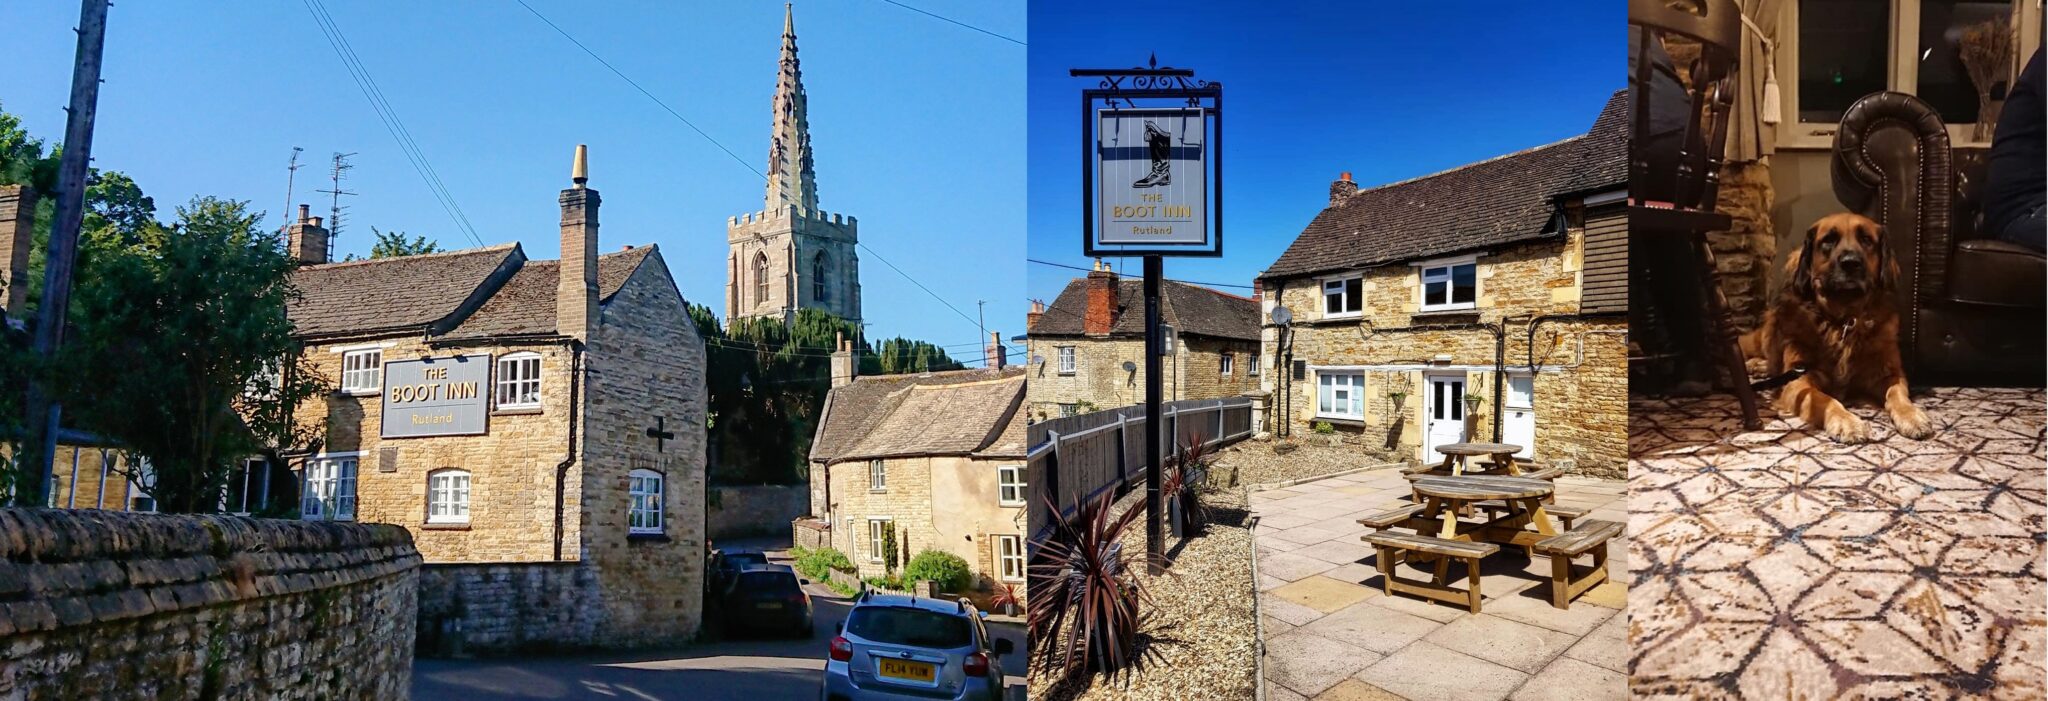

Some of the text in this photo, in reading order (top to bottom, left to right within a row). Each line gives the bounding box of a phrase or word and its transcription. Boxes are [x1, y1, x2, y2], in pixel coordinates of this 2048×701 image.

[1142, 194, 1163, 203] THE
[1113, 205, 1191, 218] BOOT INN
[1133, 226, 1172, 235] Rutland
[423, 367, 448, 380] THE
[391, 381, 478, 403] BOOT INN
[412, 413, 452, 425] Rutland
[885, 662, 906, 674] FL14
